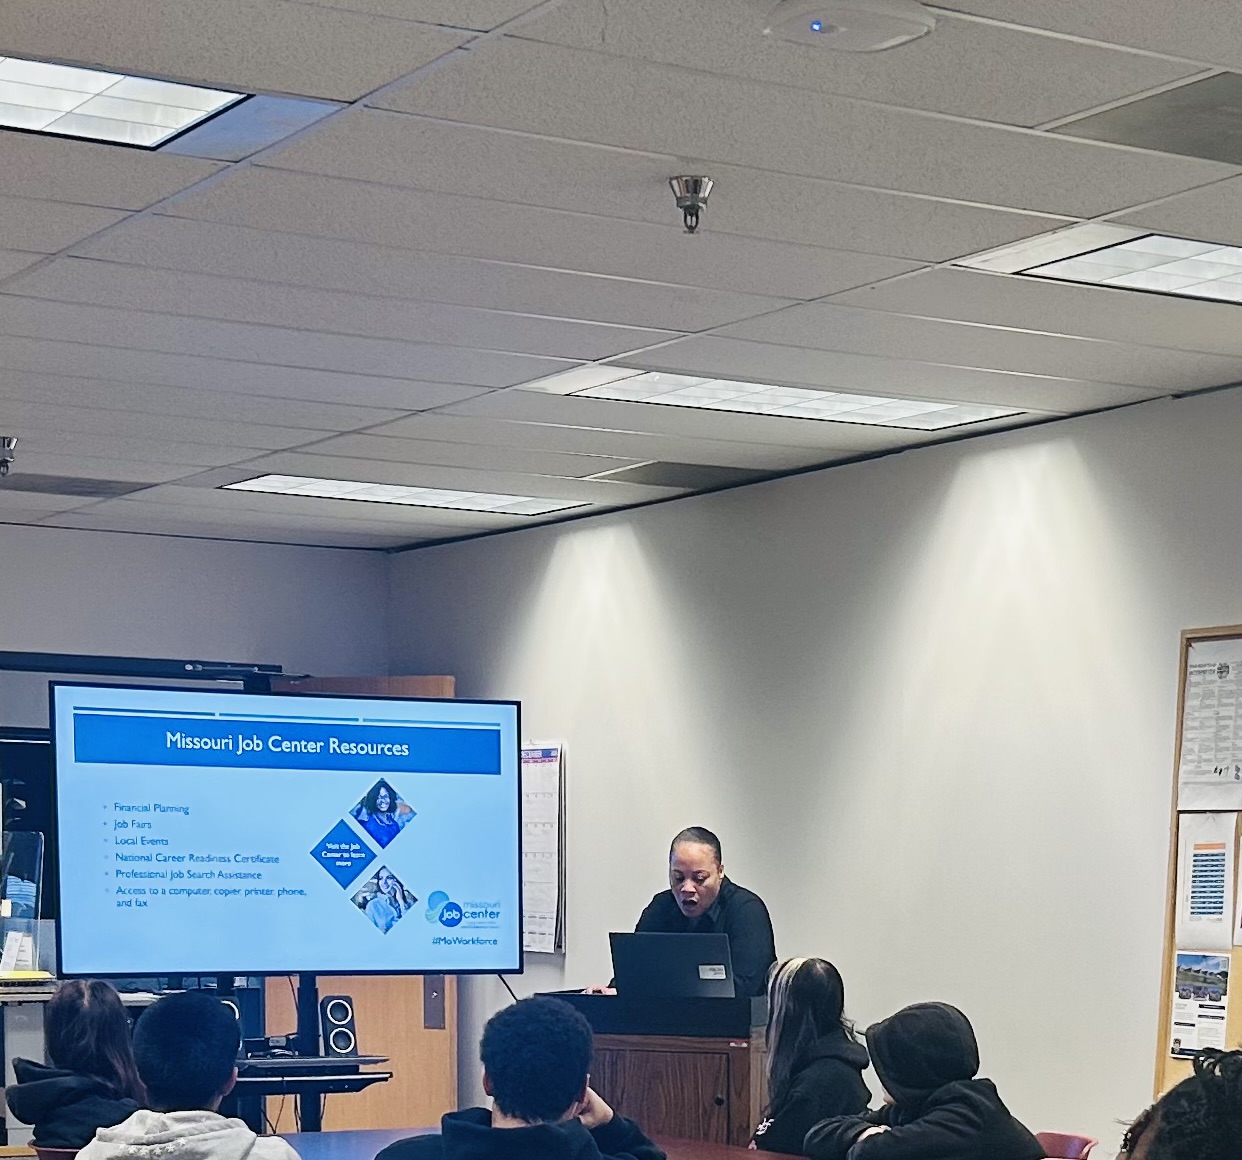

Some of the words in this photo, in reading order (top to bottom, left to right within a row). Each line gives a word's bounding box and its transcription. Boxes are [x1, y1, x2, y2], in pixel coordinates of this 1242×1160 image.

[166, 731, 233, 751] Missouri
[235, 734, 262, 756] Job
[267, 735, 324, 754] Center
[329, 737, 409, 756] Resources
[114, 802, 151, 812] Financial
[153, 803, 190, 816] Planning
[113, 820, 128, 831] Job
[131, 820, 152, 829] Fairs
[115, 835, 138, 845] Local
[140, 836, 169, 845] Events
[115, 853, 153, 862] National
[155, 853, 186, 863] Career
[188, 854, 231, 863] Readiness
[233, 854, 280, 864] Certificate
[115, 869, 167, 879] Professional
[169, 870, 184, 882] Job
[187, 870, 215, 879] Search
[217, 871, 262, 880] Assistance
[116, 886, 146, 895] Access
[148, 887, 159, 896] to
[161, 888, 166, 896] a
[116, 899, 132, 907] and
[134, 898, 148, 907] fax
[463, 901, 500, 909] missouri
[463, 908, 501, 919] center
[431, 936, 498, 945] #MoWorkforce
